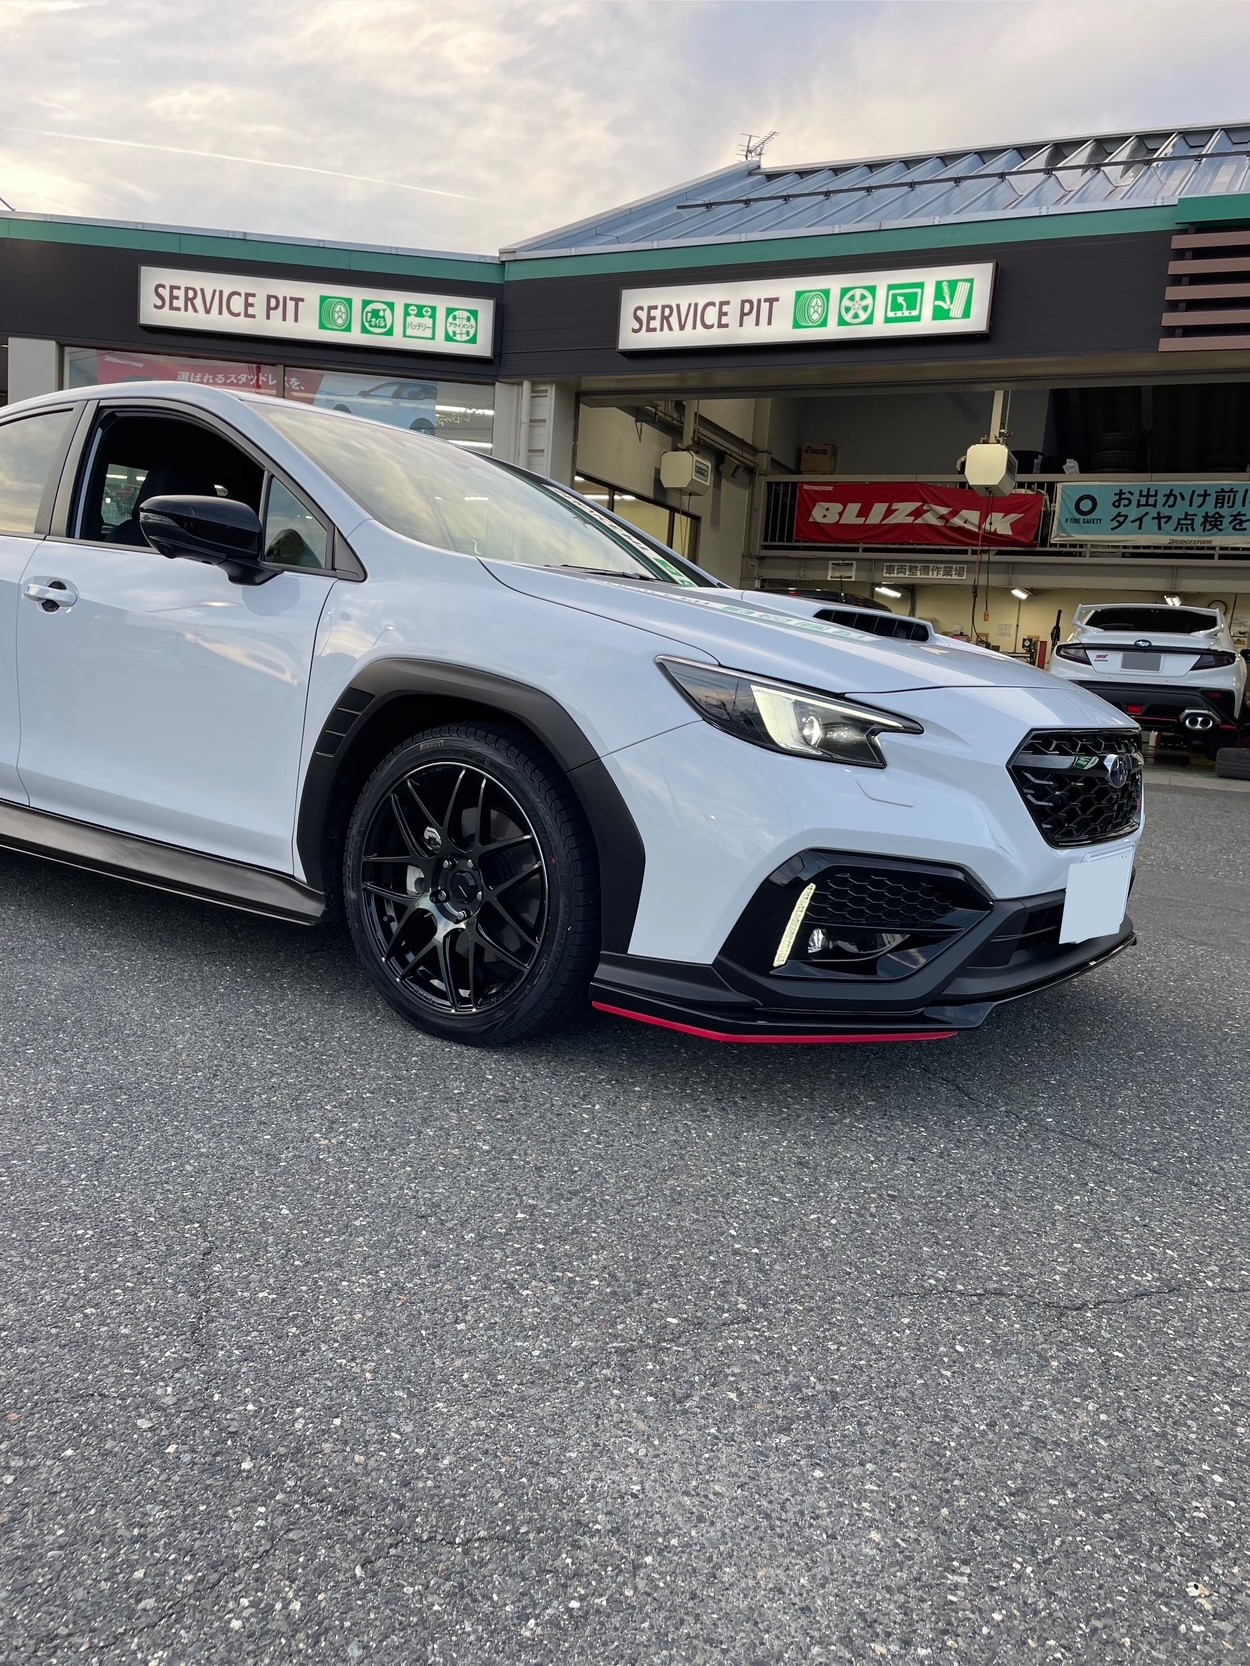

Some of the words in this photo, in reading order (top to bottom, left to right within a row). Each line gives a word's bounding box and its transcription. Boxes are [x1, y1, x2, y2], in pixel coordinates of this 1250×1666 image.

[153, 283, 257, 319] SERVICE
[265, 294, 305, 323] PIT
[370, 317, 386, 327] オイル
[631, 299, 731, 334] SERVICE
[738, 297, 780, 327] PIT
[406, 321, 432, 331] バッテリー
[448, 321, 475, 330] アライメント
[808, 501, 1025, 536] BLIZZAK
[1110, 510, 1250, 533] タイヤ点検を
[884, 564, 966, 578] 車両整備作業場
